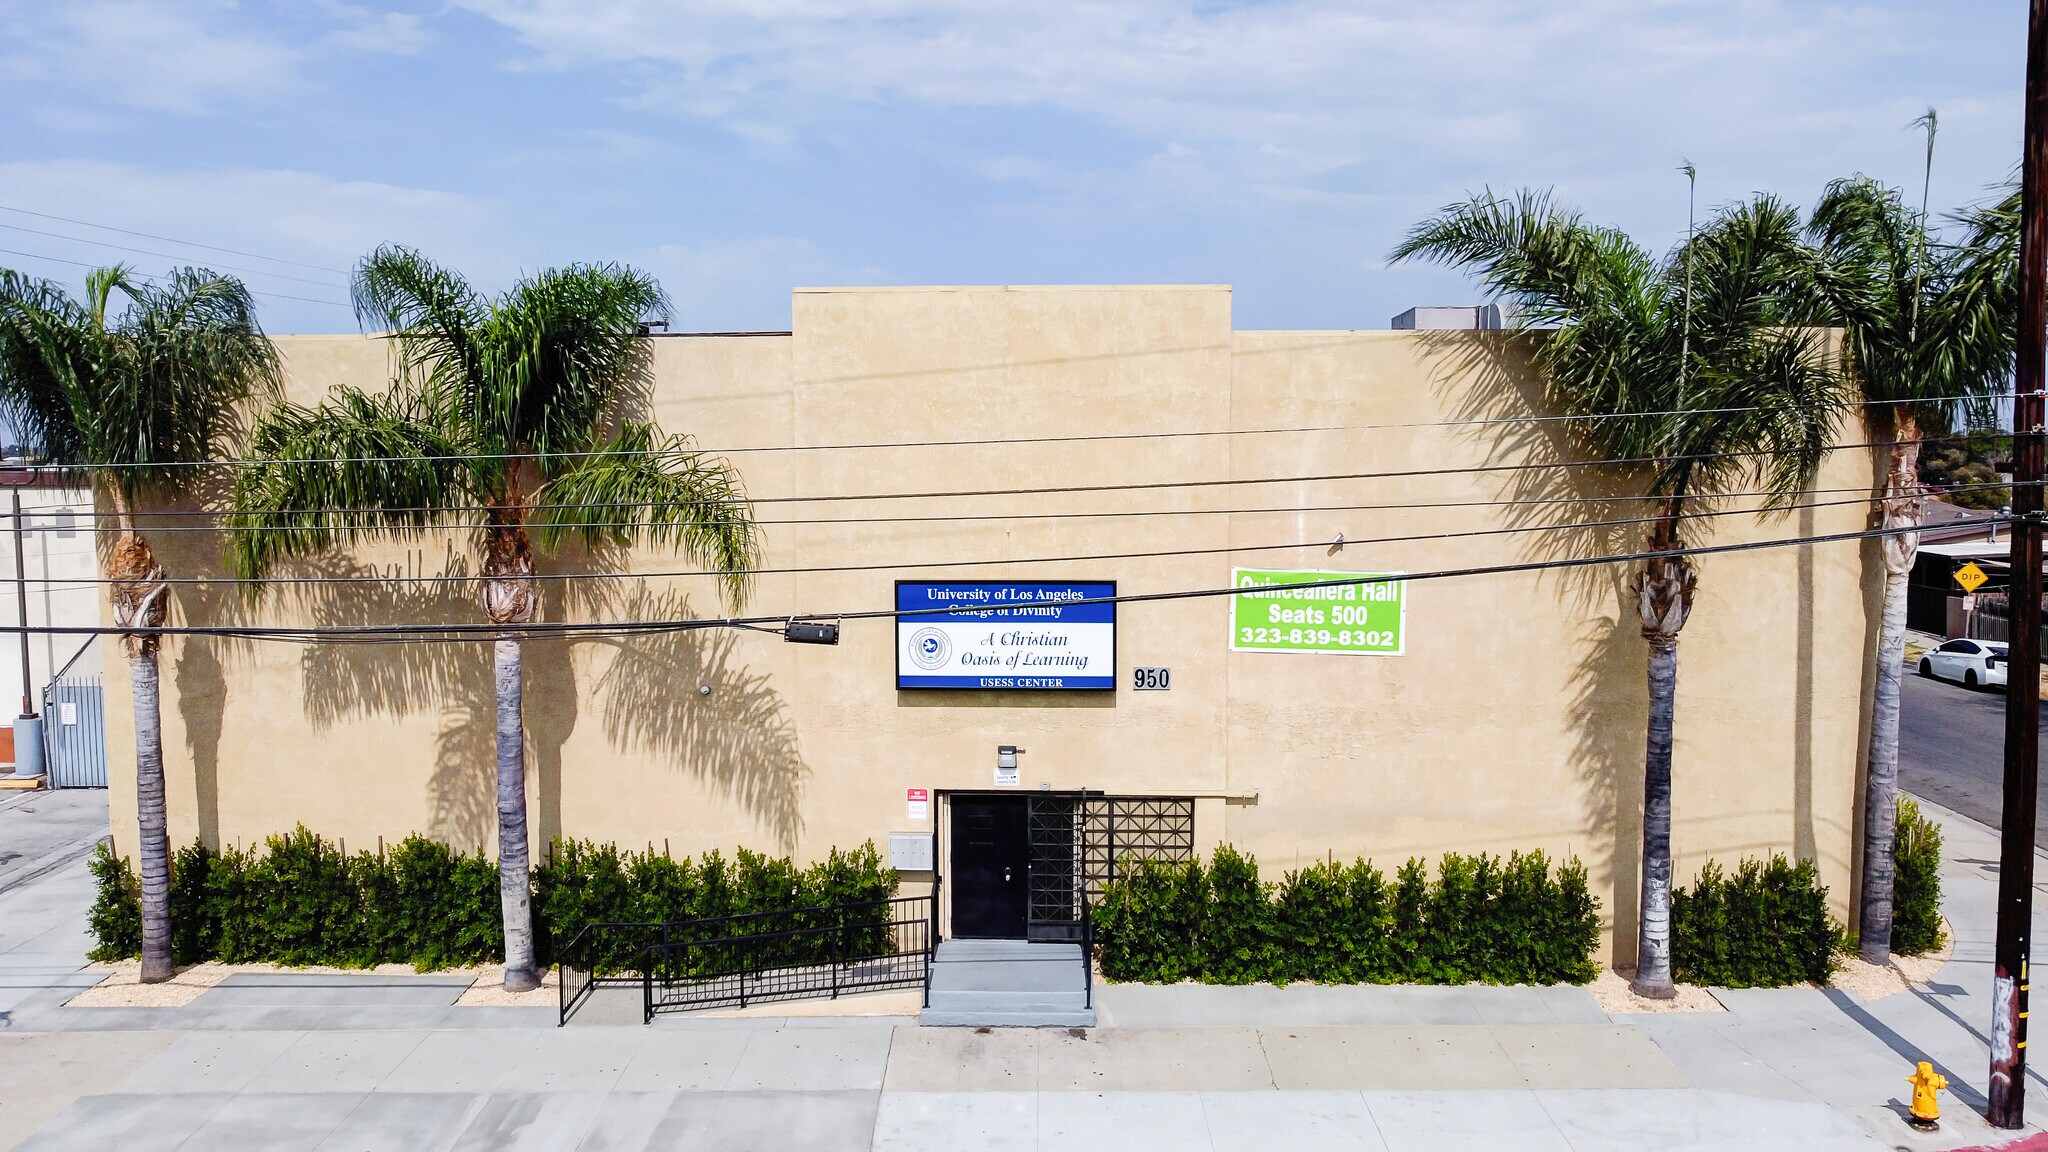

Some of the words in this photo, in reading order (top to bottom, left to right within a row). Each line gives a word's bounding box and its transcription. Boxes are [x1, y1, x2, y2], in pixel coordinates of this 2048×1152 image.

[1961, 573, 1981, 581] DIP
[926, 588, 991, 603] University
[994, 588, 1008, 600] of
[1010, 588, 1033, 600] Los
[1035, 588, 1085, 603] Angeles
[1240, 575, 1356, 601] Quinceañera
[1361, 580, 1398, 602] Hall
[1012, 605, 1063, 619] Divinity
[1268, 603, 1325, 625] Seats
[1331, 605, 1368, 626] 500
[980, 632, 995, 646] A
[1000, 630, 1068, 646] Christian
[1240, 627, 1394, 647] 323-839-8302
[961, 651, 1001, 666] Oasis
[1005, 650, 1023, 670] of
[1022, 651, 1090, 671] Learning
[980, 678, 1014, 687] USESS
[1017, 678, 1063, 687] CENTER
[1134, 668, 1169, 688] 950
